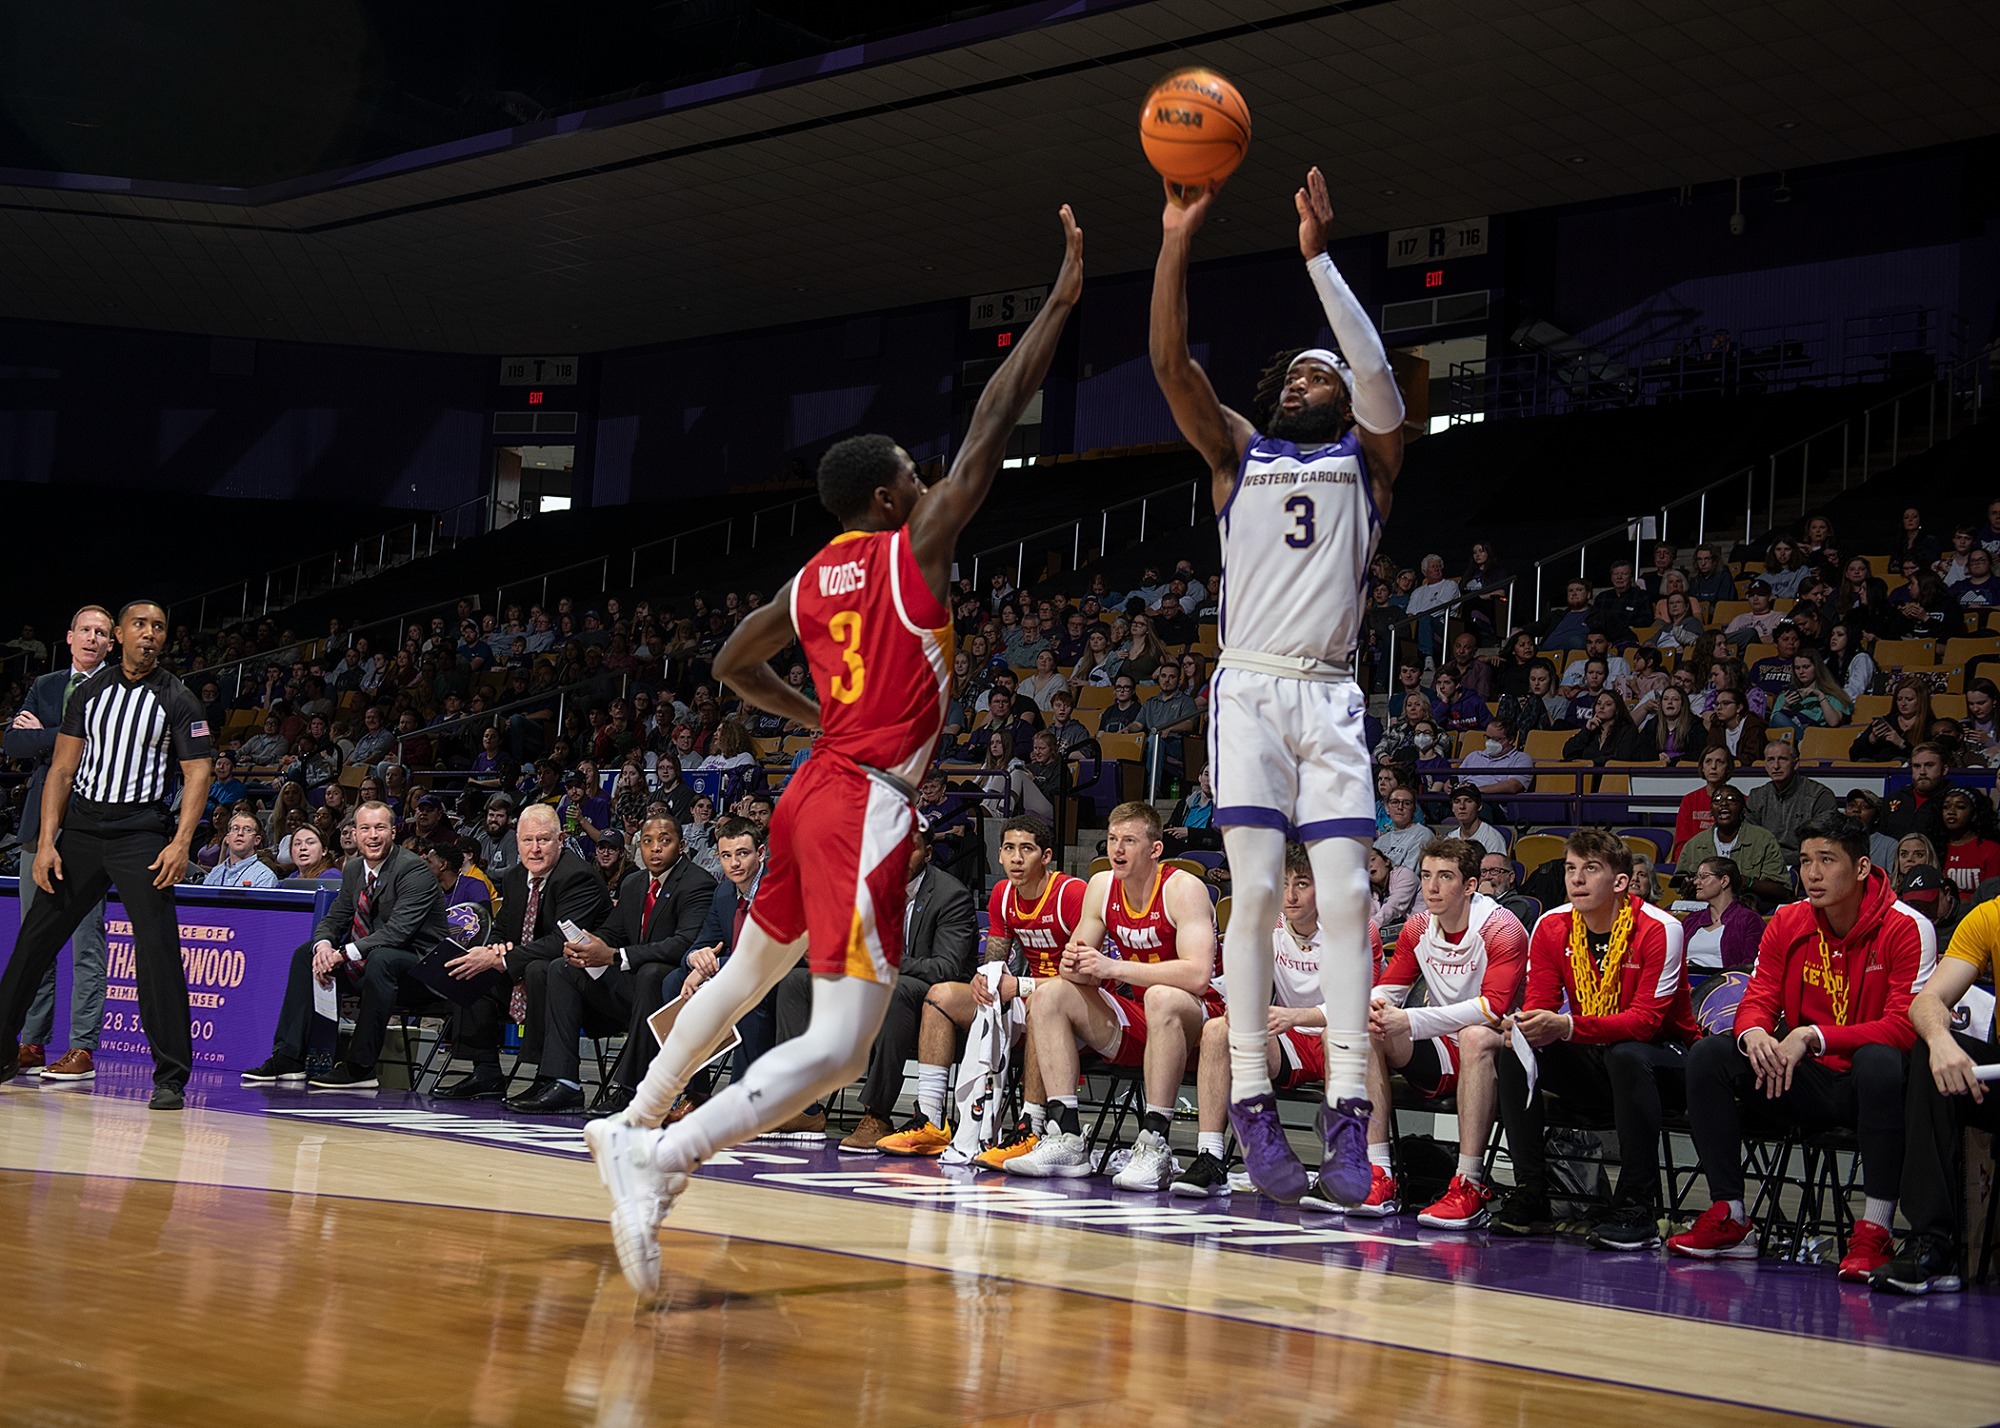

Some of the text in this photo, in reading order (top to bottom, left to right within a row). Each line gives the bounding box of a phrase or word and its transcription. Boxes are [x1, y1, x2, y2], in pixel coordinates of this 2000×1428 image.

[1397, 227, 1480, 258] 117 R 116
[1426, 271, 1443, 288] EXIT
[977, 294, 1042, 321] 118 S 117
[997, 332, 1012, 348] EXIT
[508, 360, 572, 382] 119 T 118
[529, 391, 544, 405] EXIT
[1244, 470, 1358, 488] WESTERN CAROLINA
[1284, 494, 1316, 550] 3
[828, 610, 866, 705] 3
[1764, 672, 1792, 683] SISTER
[1576, 705, 1593, 720] WC
[206, 928, 224, 939] OF
[1013, 927, 1059, 949] VMI
[1116, 924, 1163, 950] VMI
[1275, 950, 1320, 972] INSTIT
[752, 1171, 1435, 1247] COURT
